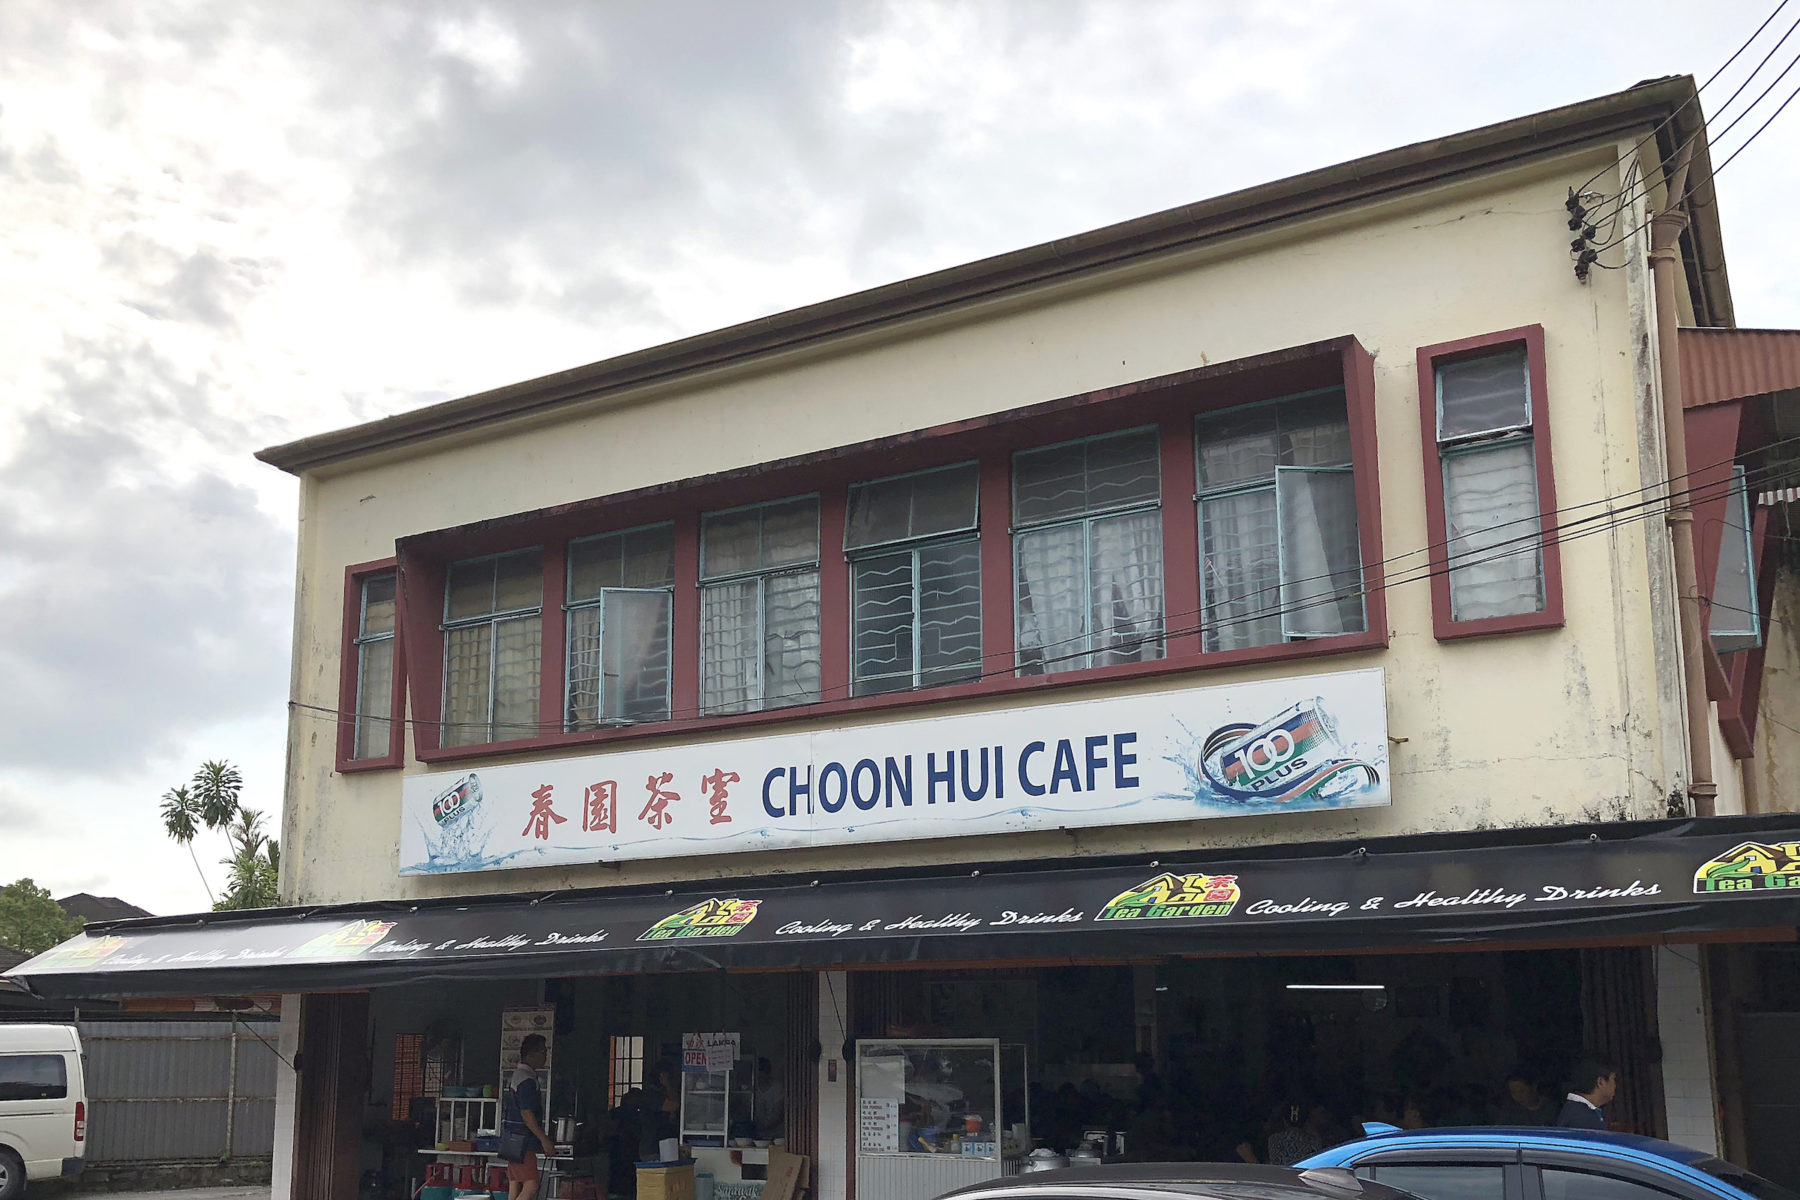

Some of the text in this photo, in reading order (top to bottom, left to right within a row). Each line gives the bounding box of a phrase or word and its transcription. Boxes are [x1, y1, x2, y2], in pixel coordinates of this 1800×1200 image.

[1234, 729, 1295, 779] 100
[762, 732, 1140, 818] CHOON HUI CAFE
[1251, 757, 1308, 791] PLUS
[437, 791, 461, 817] 100
[443, 806, 465, 824] PLUS
[522, 768, 740, 840] 春園茶室
[1698, 877, 1752, 891] Tea
[1104, 904, 1231, 919] Tea Garden
[1246, 880, 1662, 917] Cooling & Healthy Drinks
[645, 924, 742, 939] Tea Garden
[775, 908, 1083, 937] Cooling & Healthy Drinks
[435, 939, 454, 951] &
[534, 930, 609, 946] Drinks
[684, 1052, 706, 1065] OPEN
